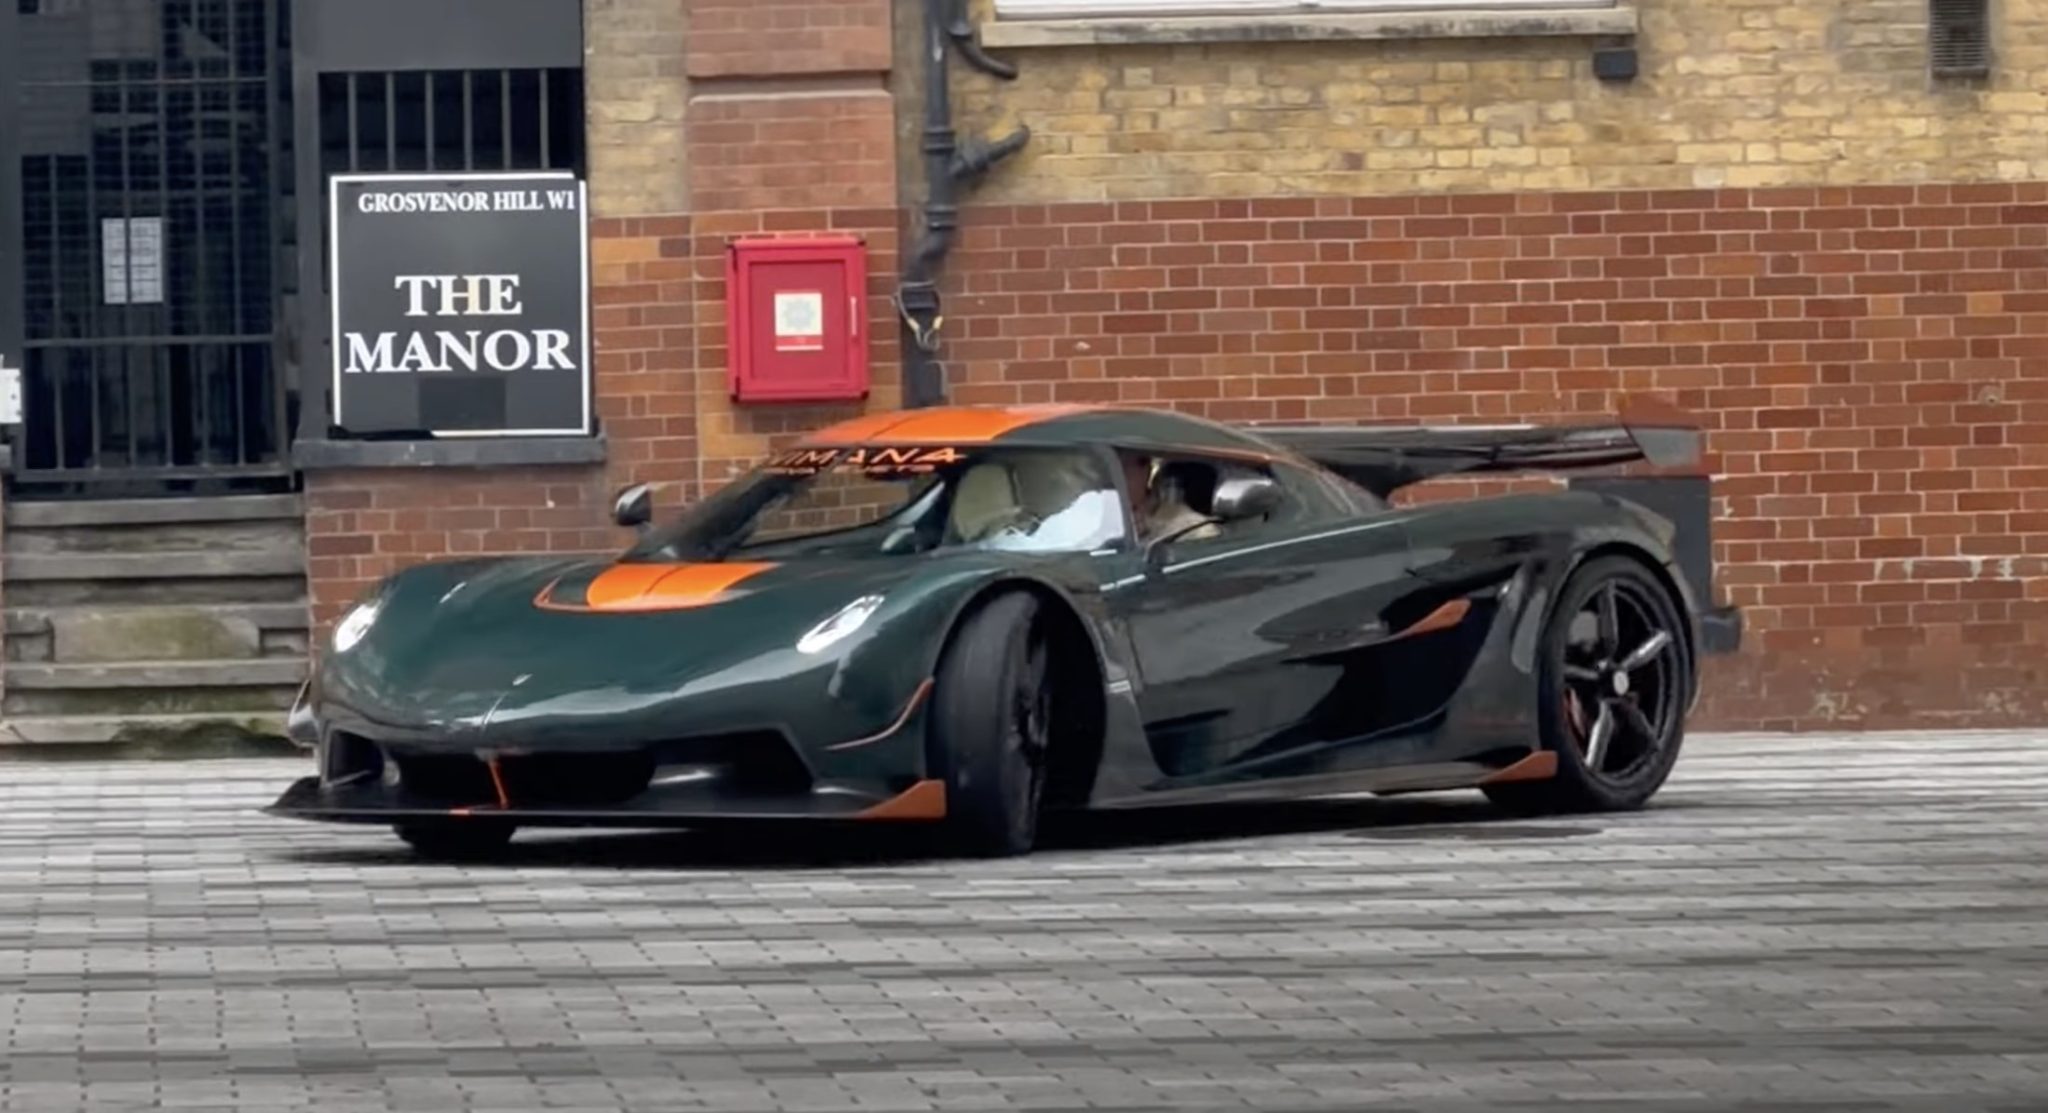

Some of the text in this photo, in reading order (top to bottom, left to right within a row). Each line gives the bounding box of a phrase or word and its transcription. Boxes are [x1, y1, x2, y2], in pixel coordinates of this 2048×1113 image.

[358, 190, 575, 213] GROSVENOR HILL W1
[394, 274, 522, 316] THE
[344, 329, 576, 373] MANOR
